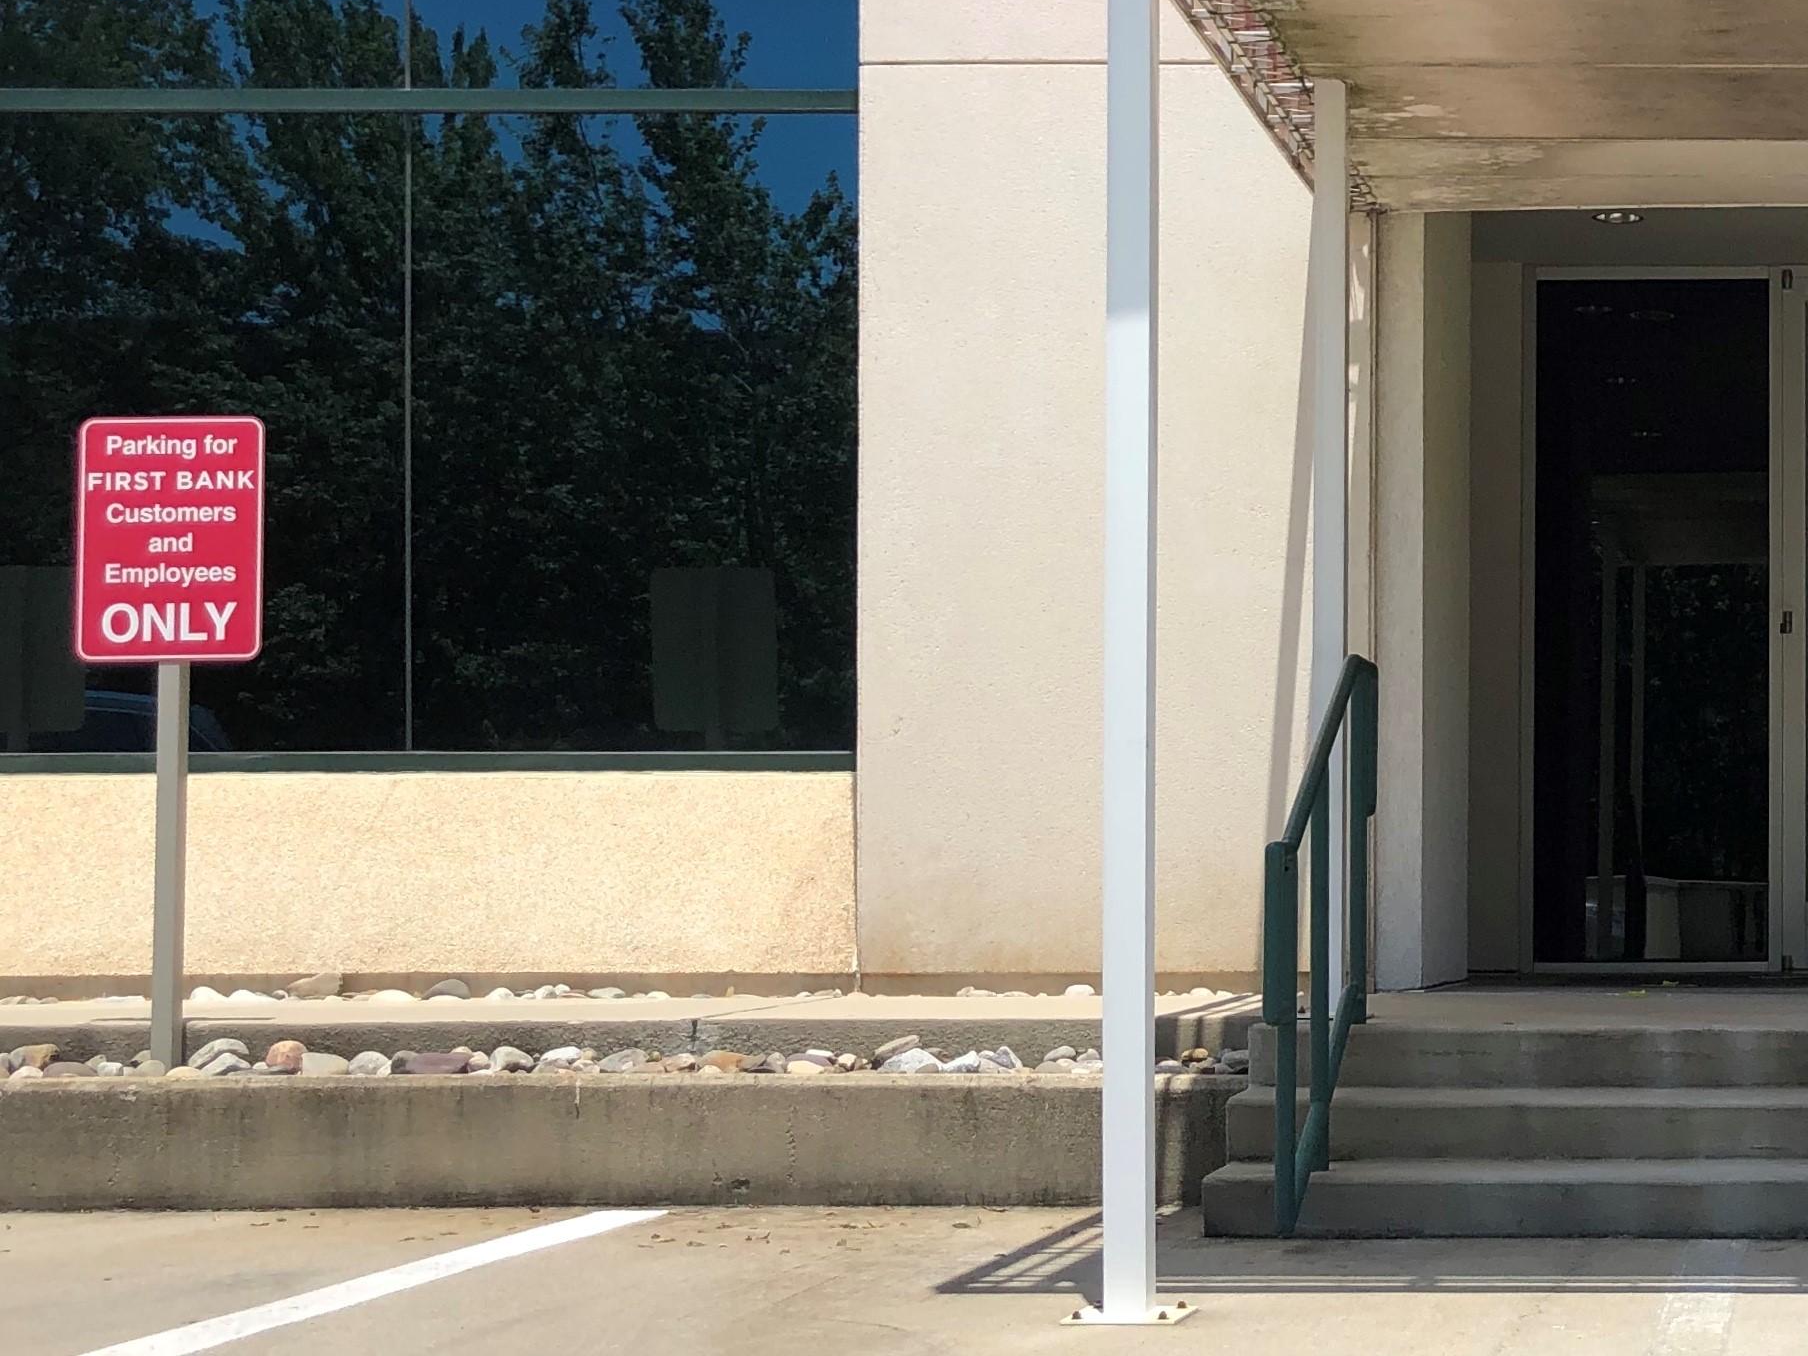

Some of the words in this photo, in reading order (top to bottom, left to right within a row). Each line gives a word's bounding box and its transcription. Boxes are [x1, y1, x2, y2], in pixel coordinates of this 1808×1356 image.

[106, 434, 197, 460] Parking
[204, 434, 238, 455] for
[87, 471, 166, 491] FIRST
[176, 470, 255, 490] BANK
[106, 503, 236, 524] Customers
[148, 532, 193, 553] and
[105, 562, 237, 588] Employees
[102, 601, 237, 644] ONLY
